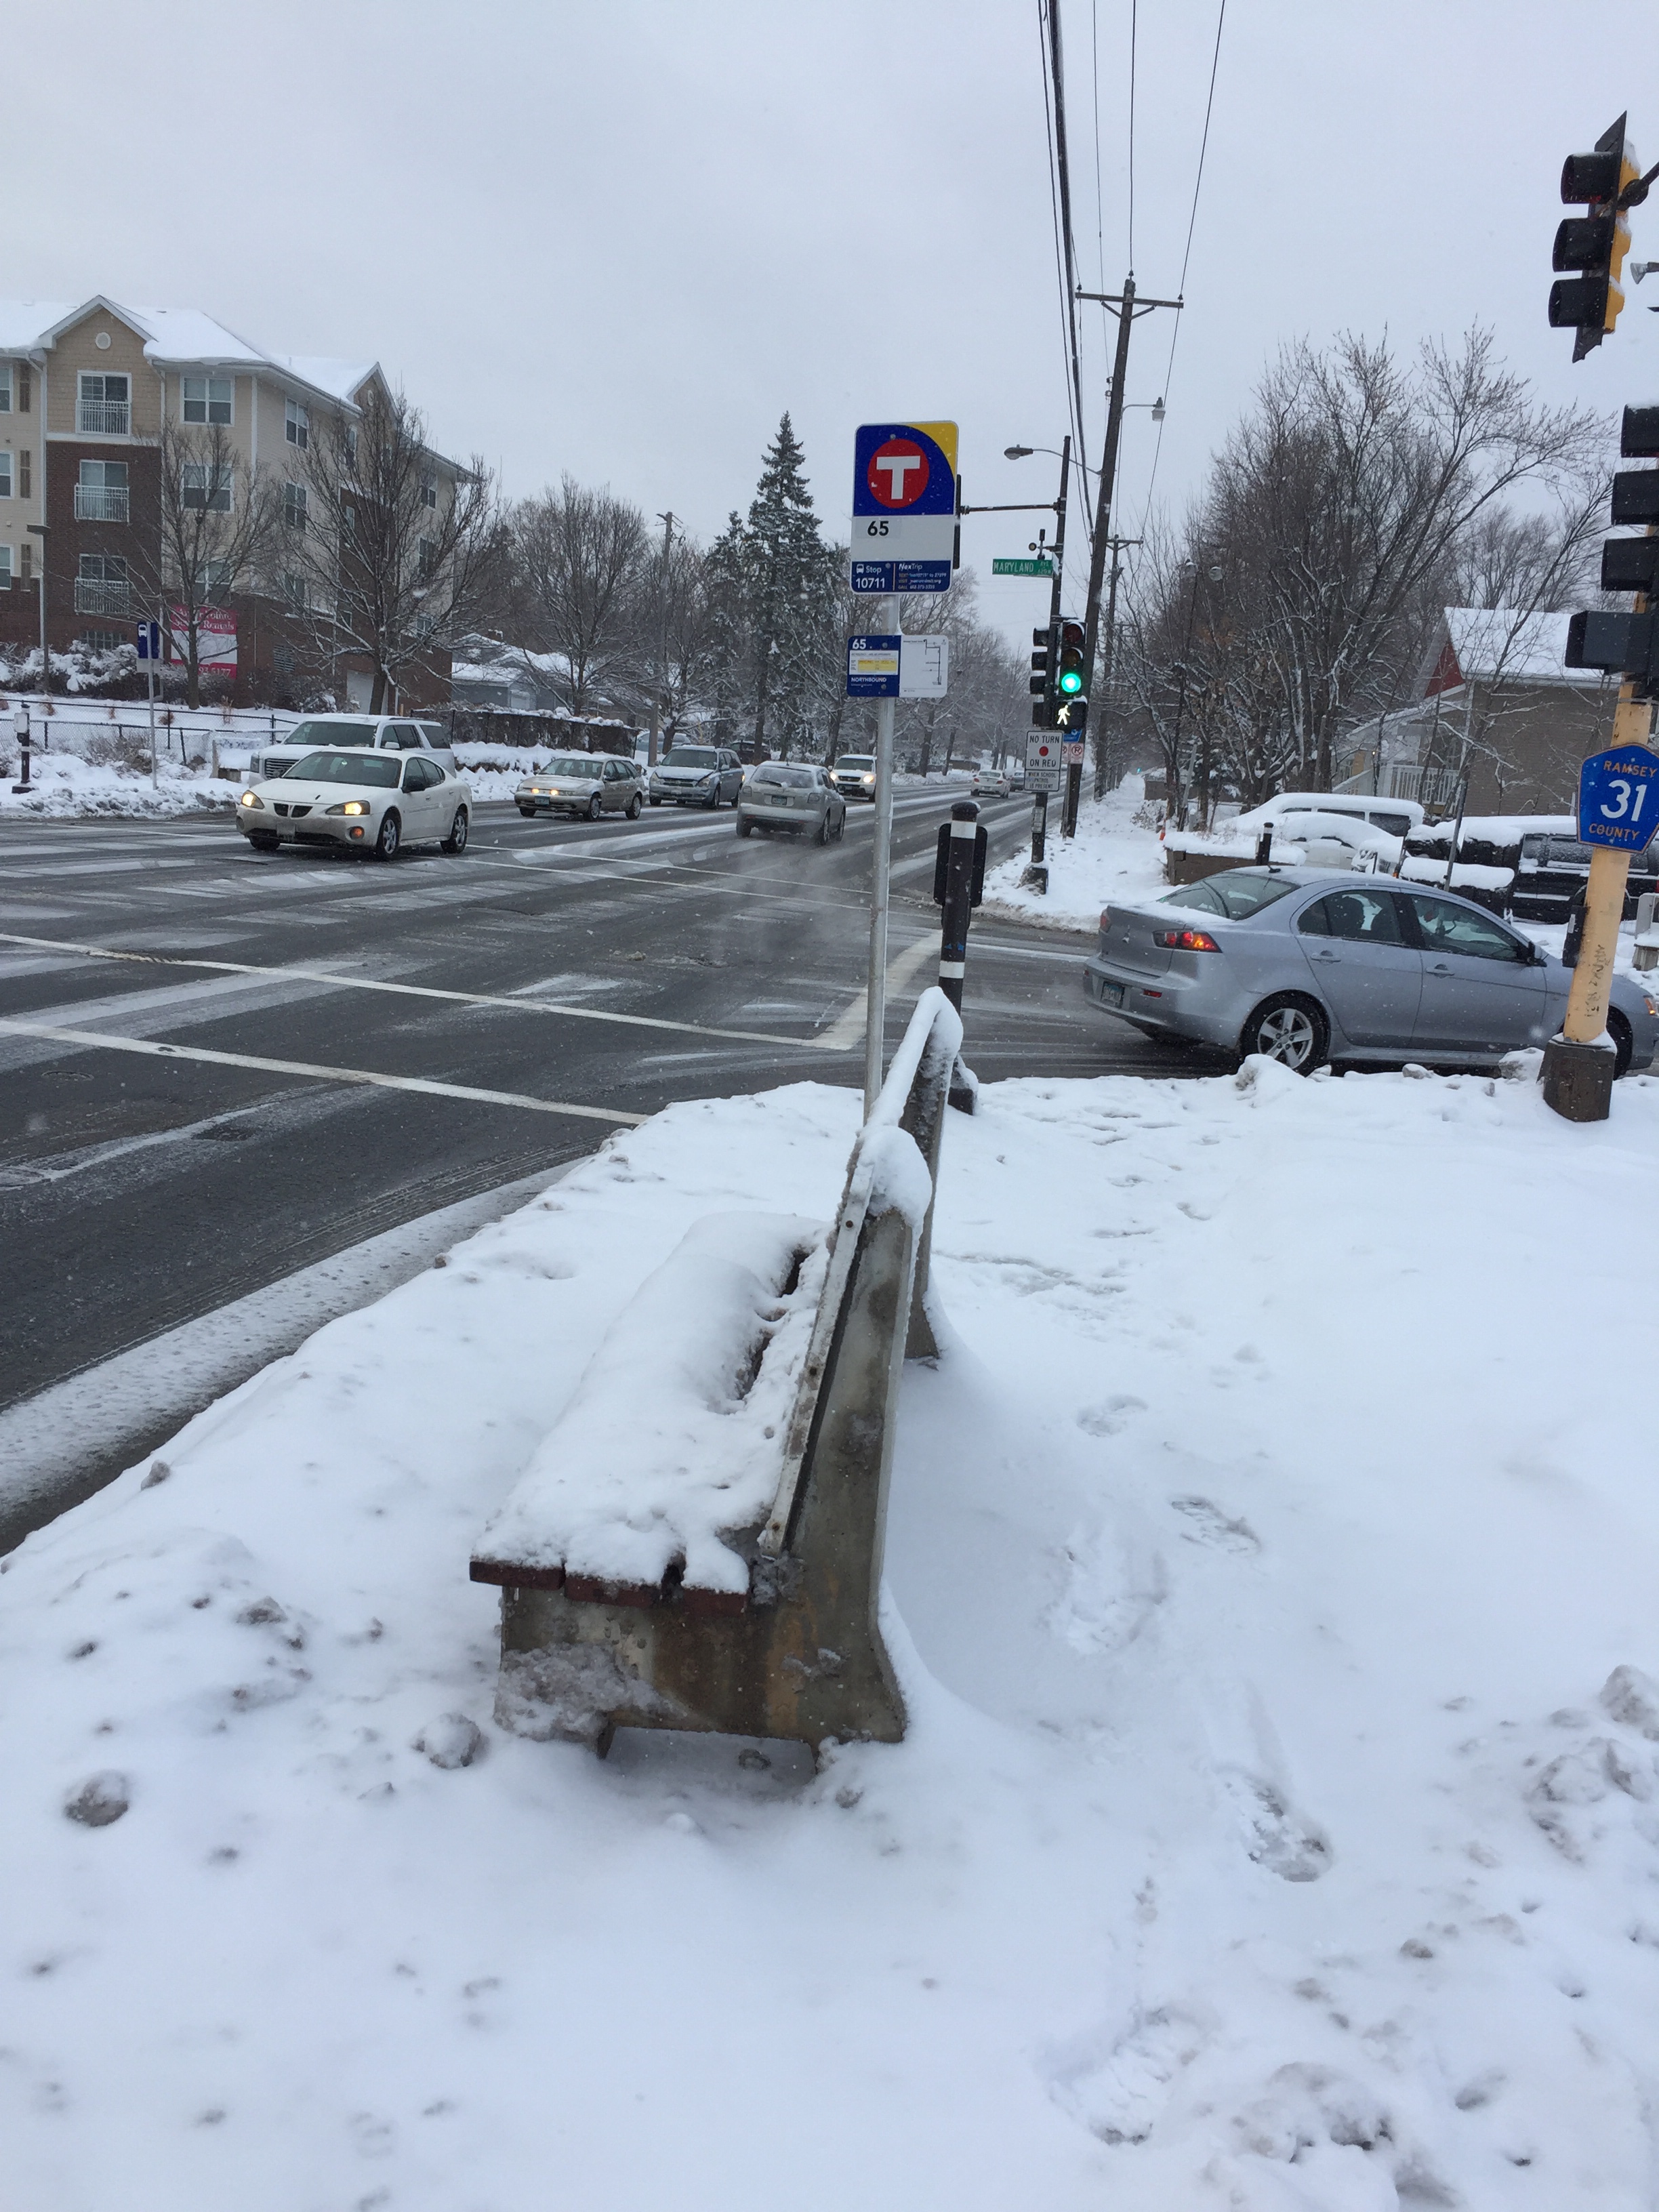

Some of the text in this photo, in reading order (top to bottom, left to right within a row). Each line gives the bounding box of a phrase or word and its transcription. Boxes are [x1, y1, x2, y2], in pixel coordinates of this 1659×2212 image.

[876, 455, 921, 499] T
[867, 520, 889, 537] 65
[865, 565, 882, 575] Stop
[899, 563, 923, 571] NexTrip
[993, 561, 1035, 573] MARYLAND
[855, 577, 885, 589] 10711
[852, 638, 867, 650] 65
[1029, 735, 1040, 743] NO
[1042, 735, 1059, 743] TURN
[1029, 759, 1057, 768] ON RED
[1603, 760, 1658, 779] RAMSEY
[1600, 779, 1647, 822] 31
[1589, 823, 1641, 841] COUNTY
